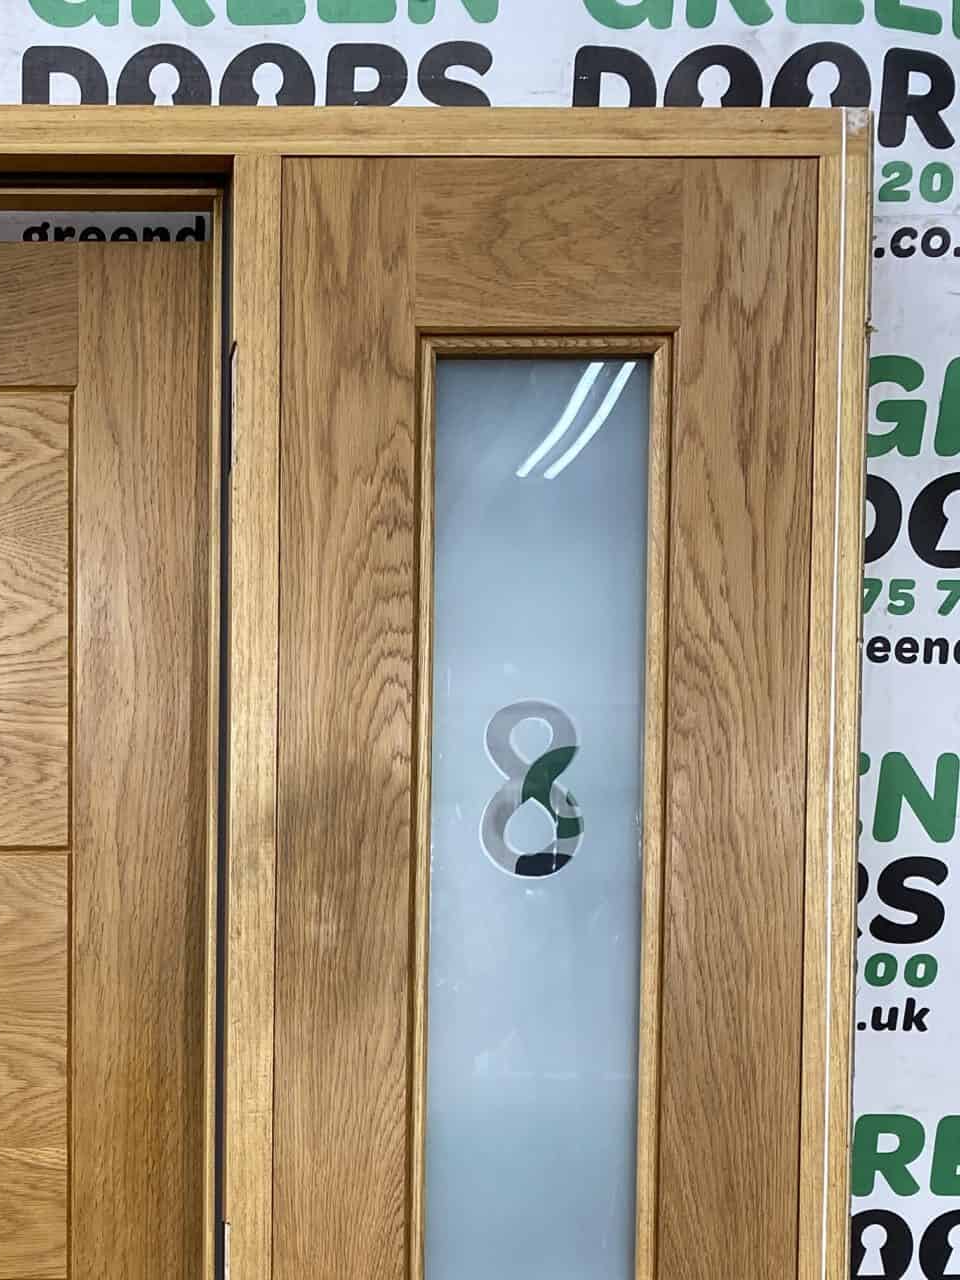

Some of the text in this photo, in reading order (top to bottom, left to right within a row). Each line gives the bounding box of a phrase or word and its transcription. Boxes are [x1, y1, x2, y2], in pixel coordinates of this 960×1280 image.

[867, 636, 960, 664] een
[480, 697, 584, 879] 8
[859, 751, 960, 843] N
[857, 856, 949, 944] S
